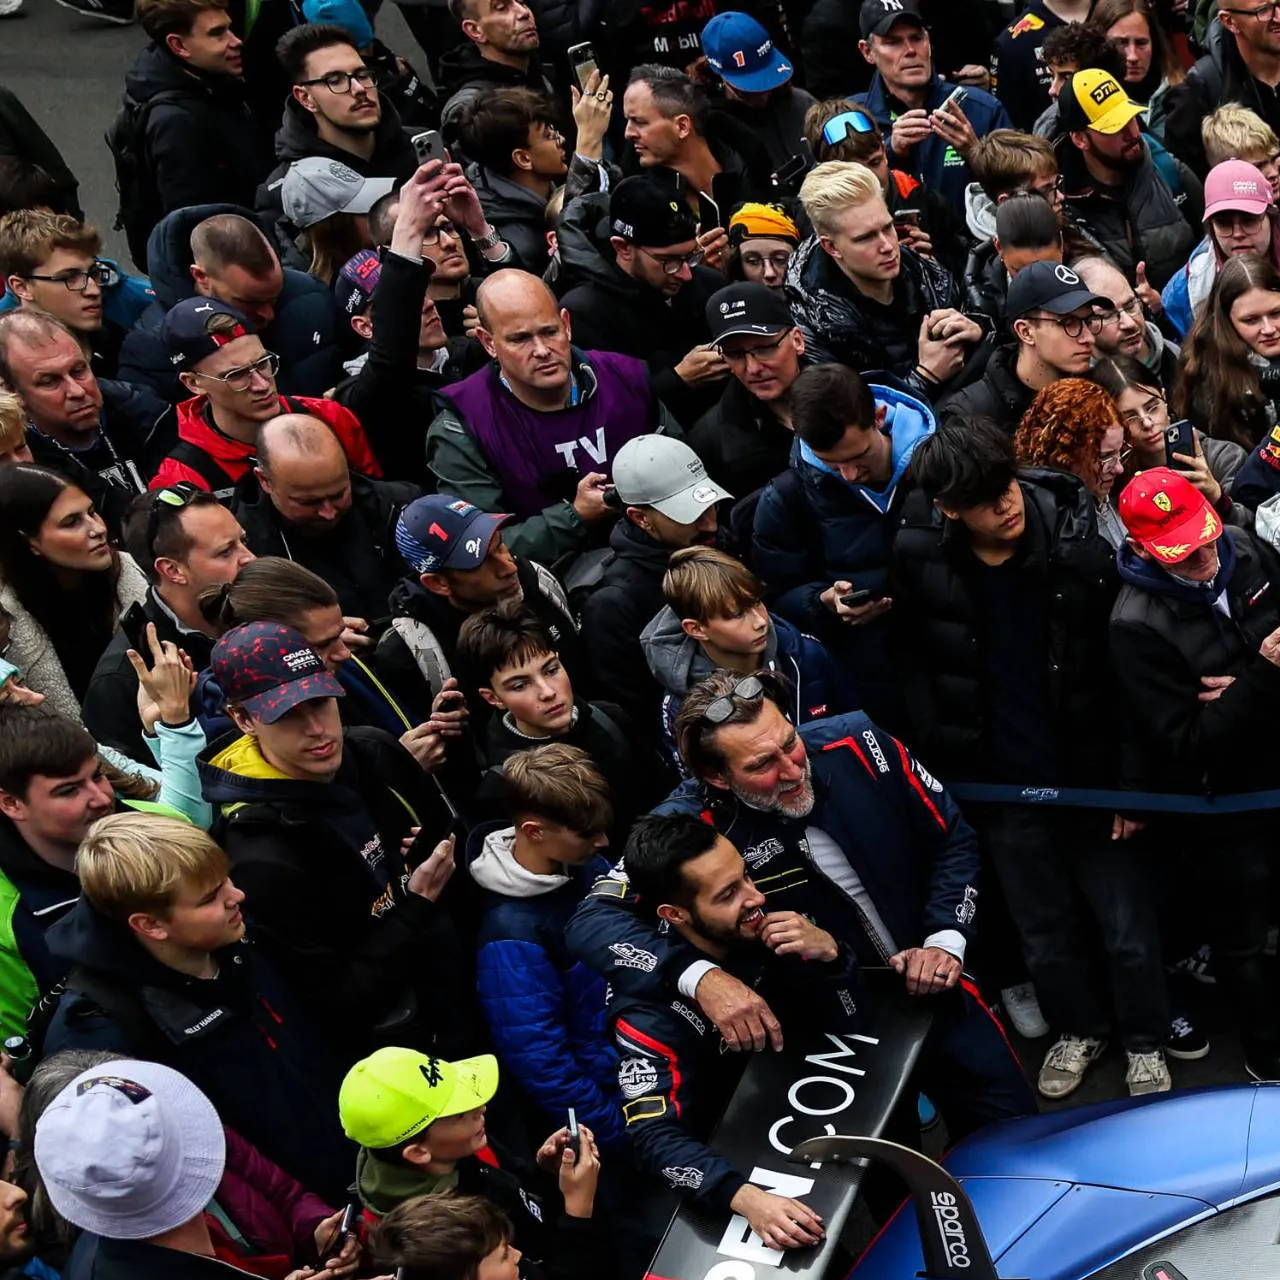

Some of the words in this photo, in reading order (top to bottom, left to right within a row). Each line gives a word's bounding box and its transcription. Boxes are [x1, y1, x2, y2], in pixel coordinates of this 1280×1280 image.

[1093, 80, 1118, 101] DTM
[554, 427, 607, 472] TV
[862, 729, 889, 774] sparco
[669, 999, 705, 1037] sparco
[931, 1192, 971, 1269] sparco
